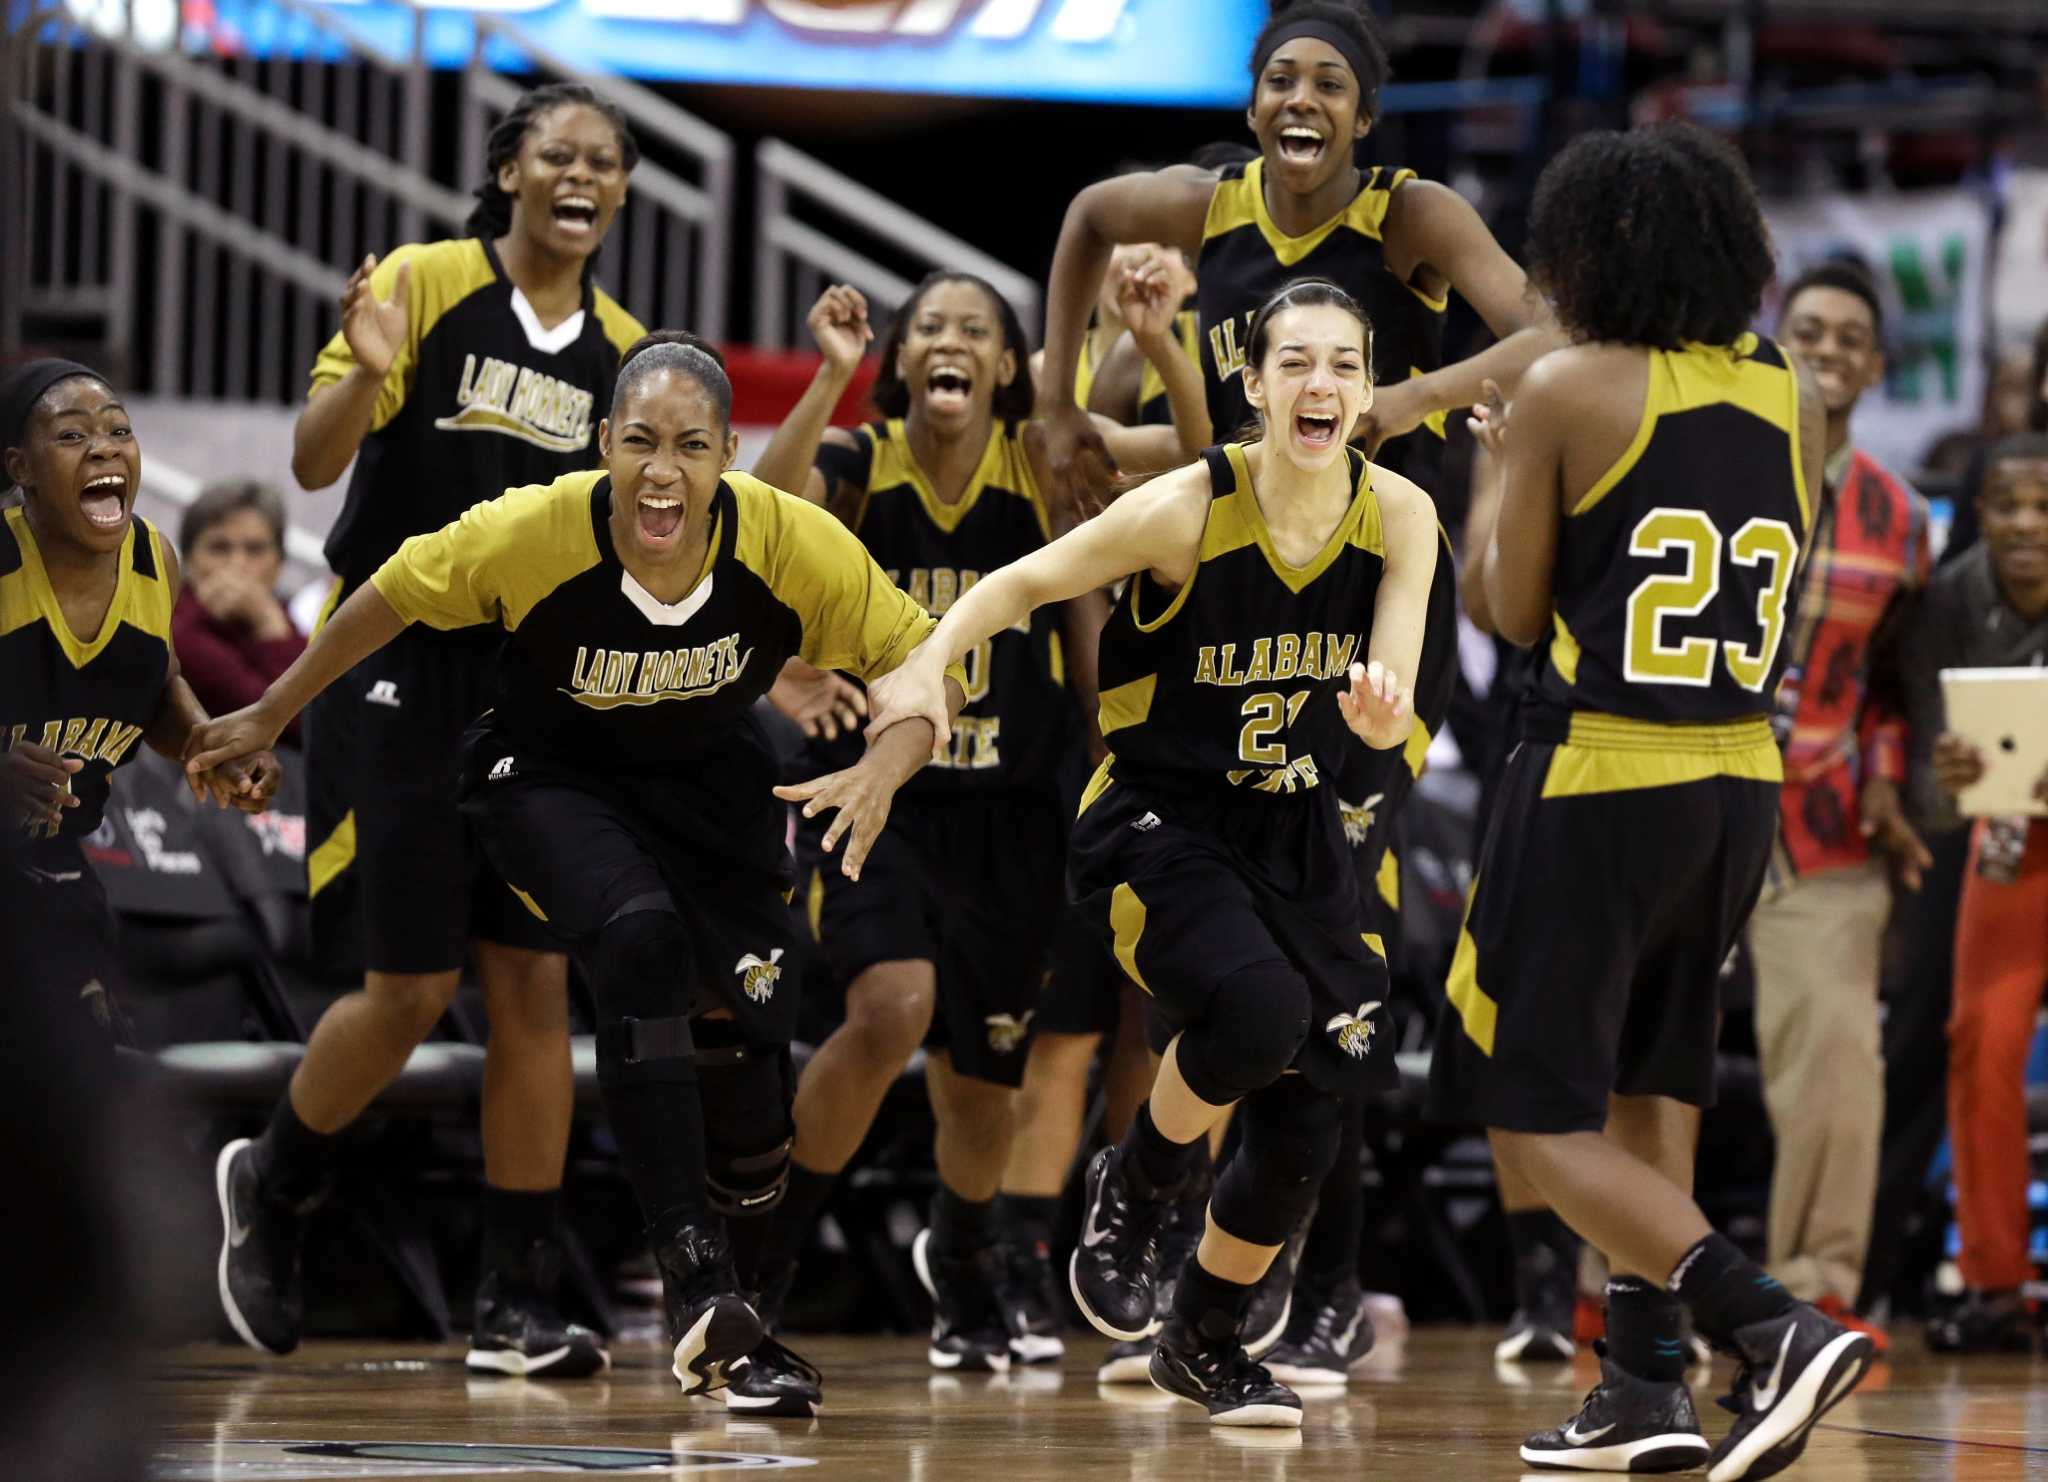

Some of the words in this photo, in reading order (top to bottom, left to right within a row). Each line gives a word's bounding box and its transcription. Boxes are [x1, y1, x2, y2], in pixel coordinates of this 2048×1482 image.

[457, 353, 518, 412] LADY
[509, 366, 594, 441] HORNETS
[1623, 507, 1799, 693] 23
[572, 646, 639, 696] LADY
[636, 632, 740, 695] HORNETS
[1193, 631, 1362, 686] ALABAM
